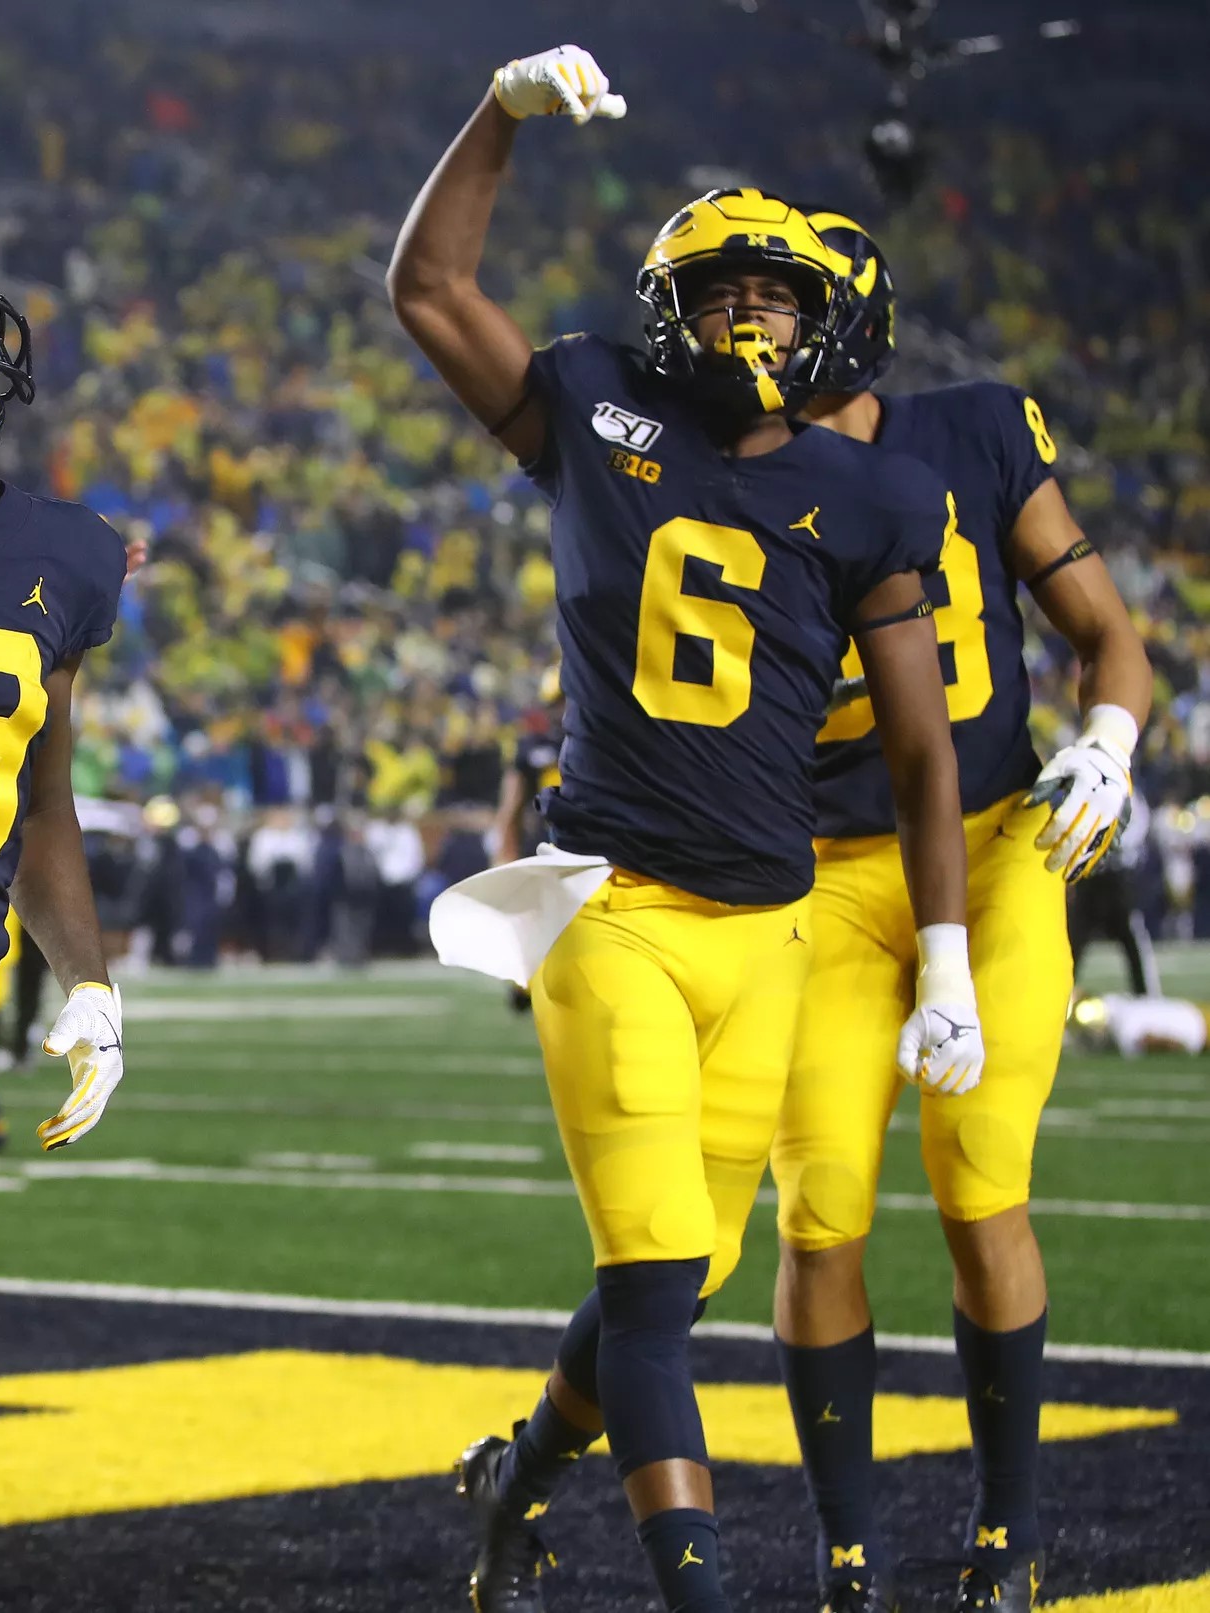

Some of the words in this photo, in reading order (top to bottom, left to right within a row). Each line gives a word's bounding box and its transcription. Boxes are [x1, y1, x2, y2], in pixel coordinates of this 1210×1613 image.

[747, 233, 769, 247] M
[594, 402, 663, 452] 150
[1023, 396, 1057, 465] 8
[632, 516, 767, 728] 6
[975, 1525, 1008, 1549] M
[831, 1544, 866, 1568] M
